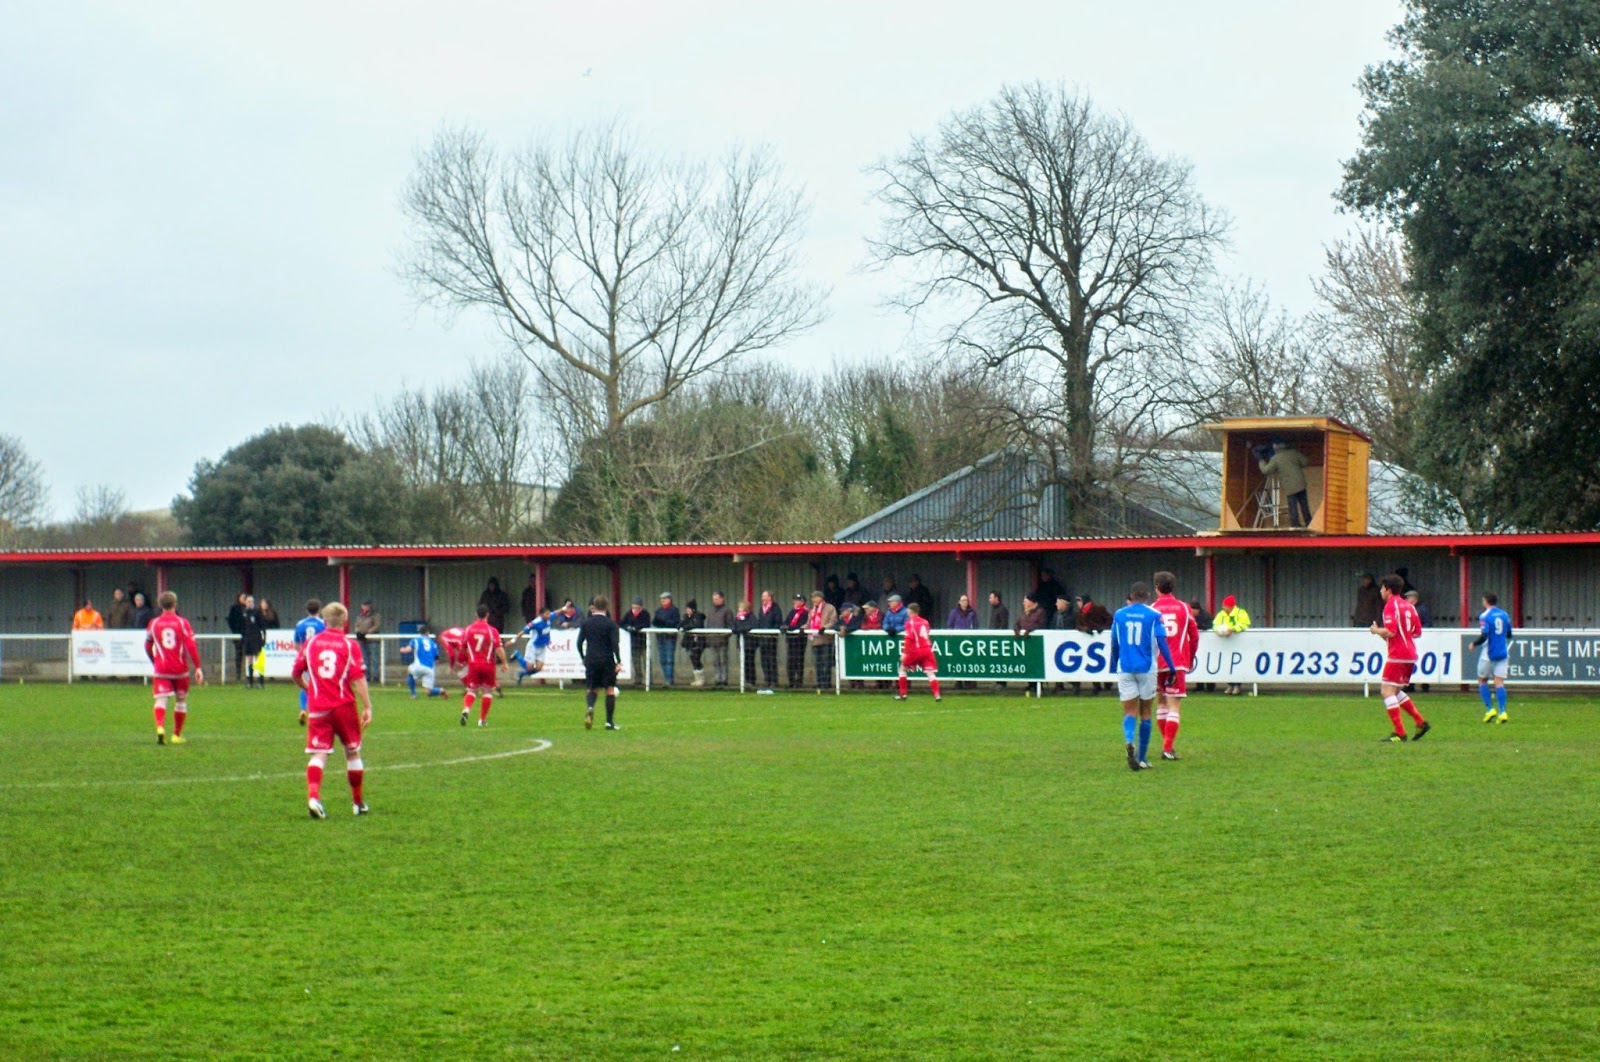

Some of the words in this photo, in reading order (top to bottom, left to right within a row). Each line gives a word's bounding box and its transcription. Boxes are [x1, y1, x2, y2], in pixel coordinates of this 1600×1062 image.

[1125, 621, 1142, 645] 11
[1163, 613, 1178, 637] 5
[1494, 617, 1503, 635] 9
[161, 627, 176, 649] 8
[473, 633, 485, 652] 7
[861, 639, 953, 656] IMPEAL
[959, 639, 1026, 657] GREEN
[1054, 640, 1119, 674] GS
[1507, 640, 1560, 658] THE
[317, 649, 337, 679] 3
[862, 663, 893, 673] HYTHE
[989, 664, 1026, 674] 233640
[1255, 652, 1340, 675] 01233
[1349, 651, 1452, 676] 5001
[1527, 664, 1537, 677] &
[1539, 664, 1563, 677] SPA
